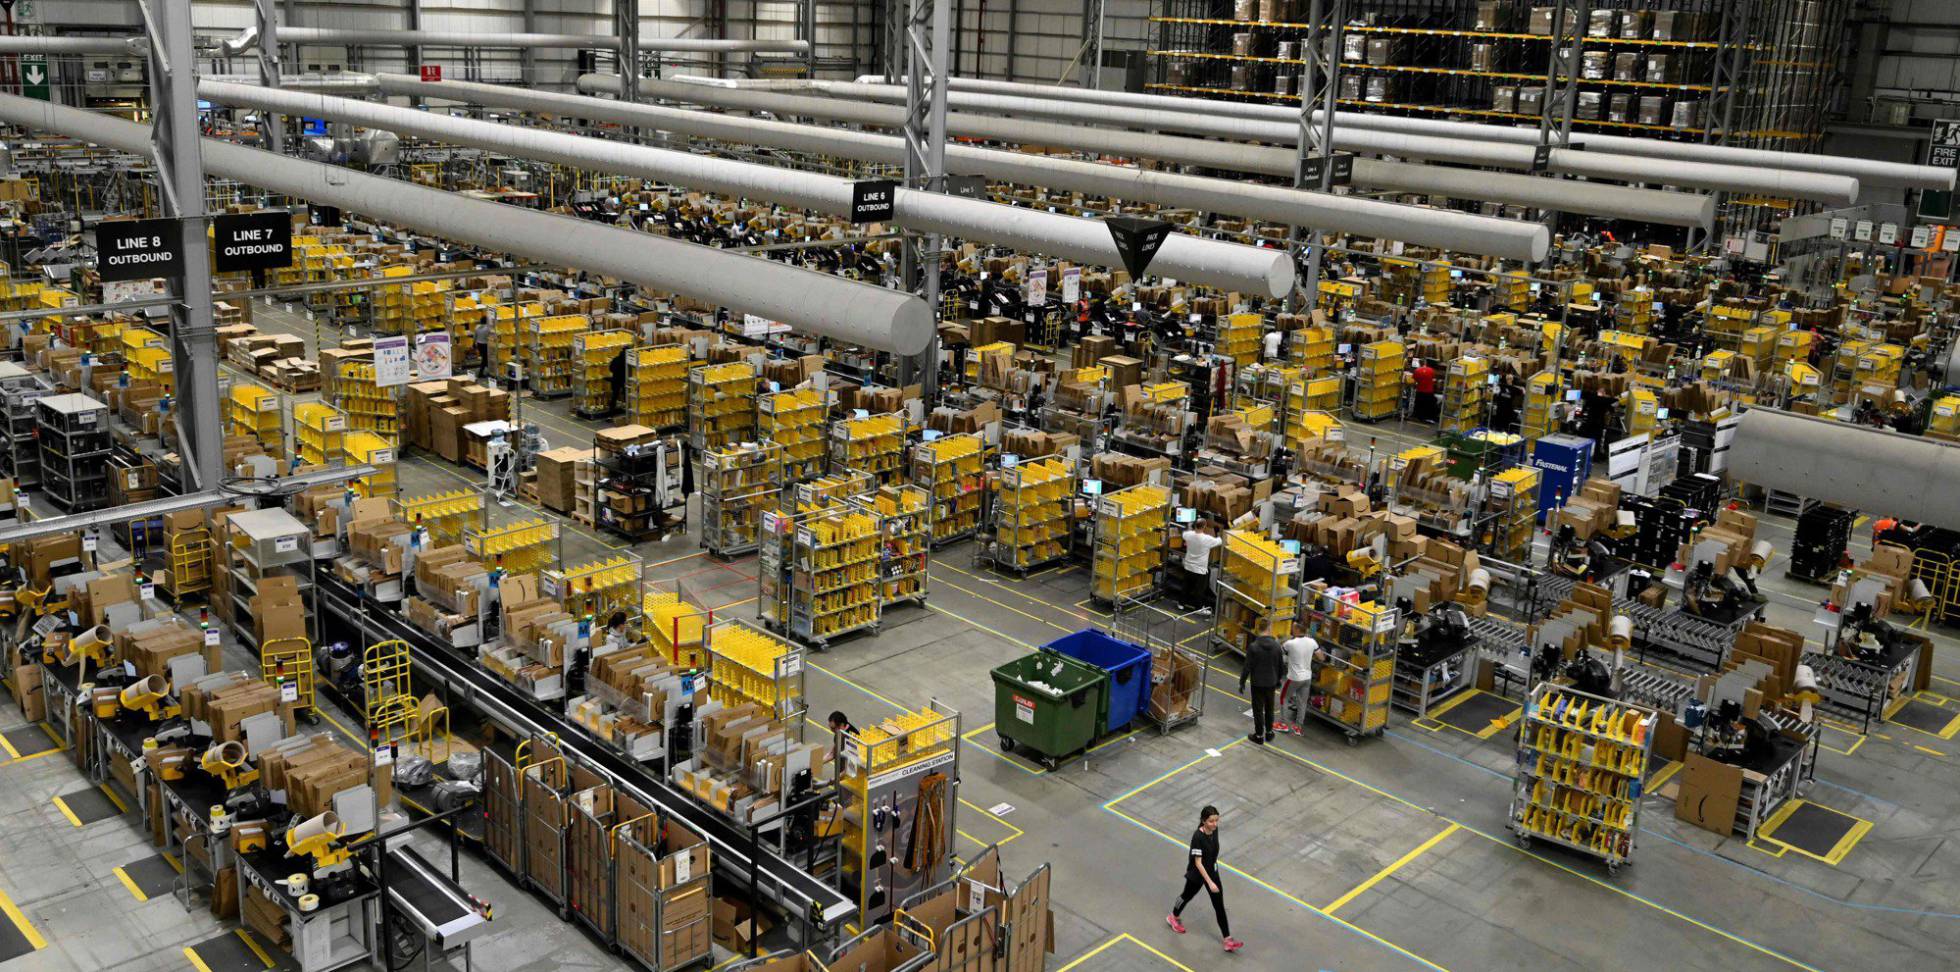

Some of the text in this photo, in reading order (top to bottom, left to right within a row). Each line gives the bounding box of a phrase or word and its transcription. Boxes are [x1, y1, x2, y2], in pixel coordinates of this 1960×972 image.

[1933, 147, 1957, 157] FIRE
[1932, 157, 1956, 166] EXIT
[863, 192, 886, 201] LINE 6
[857, 203, 890, 212] OUTBOUND
[233, 229, 273, 242] LINE 7
[117, 236, 162, 250] LINE 8
[224, 243, 283, 256] OUTBOUND
[108, 251, 173, 265] OUTBOUND
[901, 753, 953, 776] CLEANING STATION
